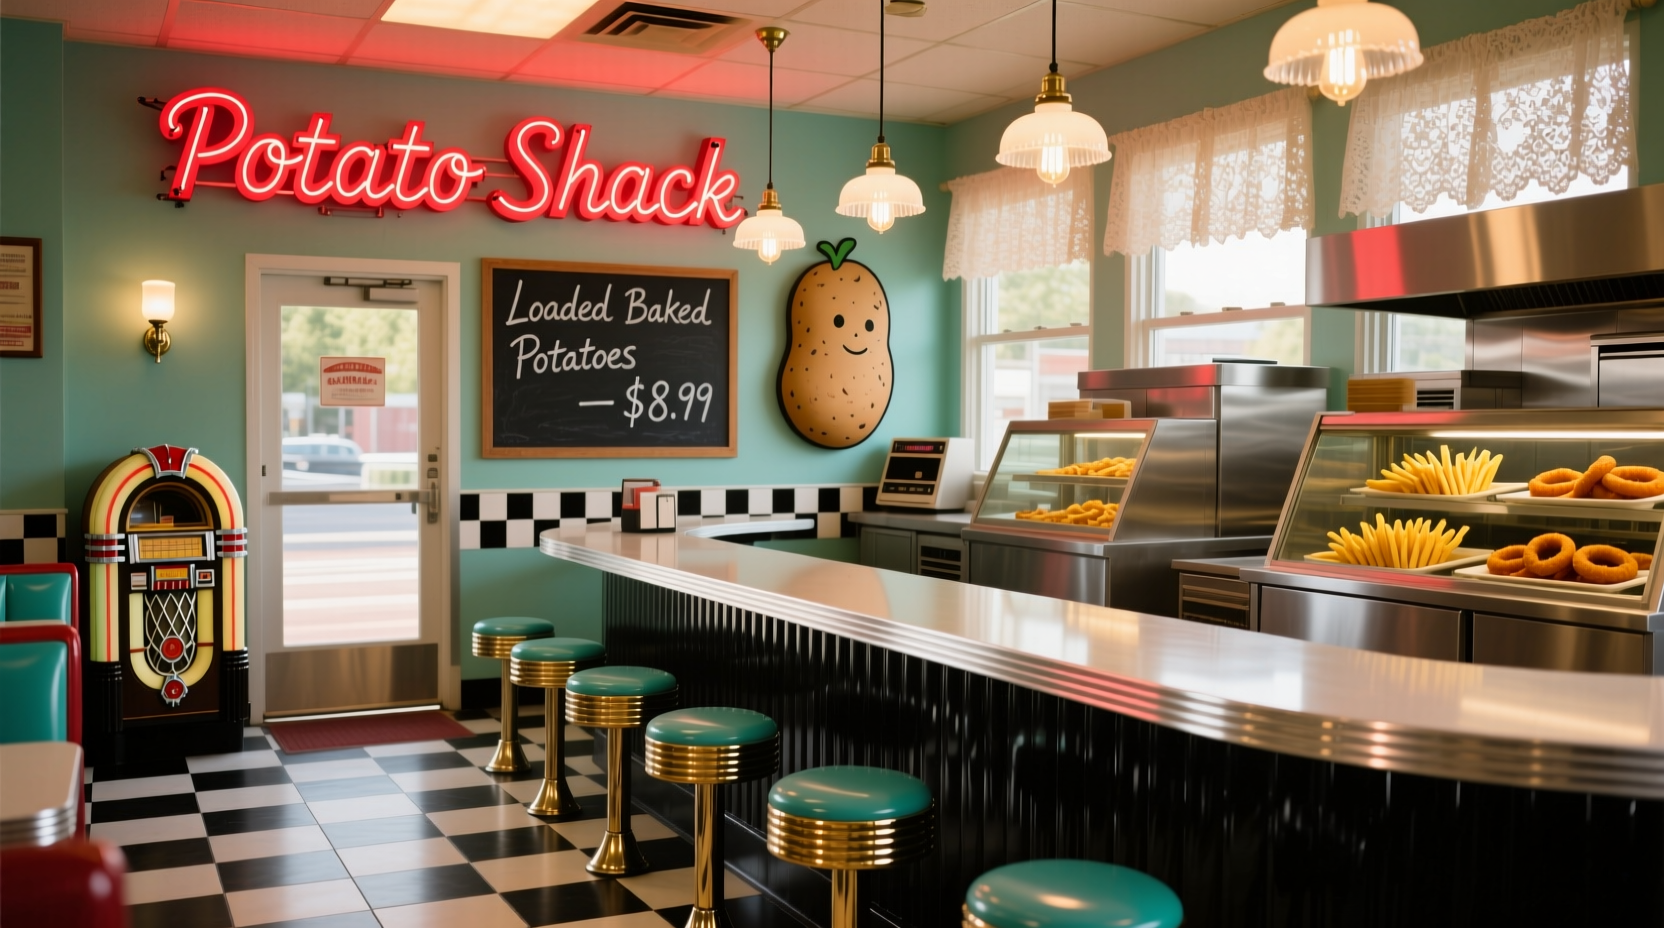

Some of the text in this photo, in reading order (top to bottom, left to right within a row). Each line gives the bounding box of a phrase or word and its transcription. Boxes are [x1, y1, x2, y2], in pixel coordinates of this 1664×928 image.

[160, 87, 747, 228] Potato Shack
[505, 279, 712, 326] Loaded Baked
[509, 333, 637, 379] Potatoes
[623, 376, 713, 428] $8.99
